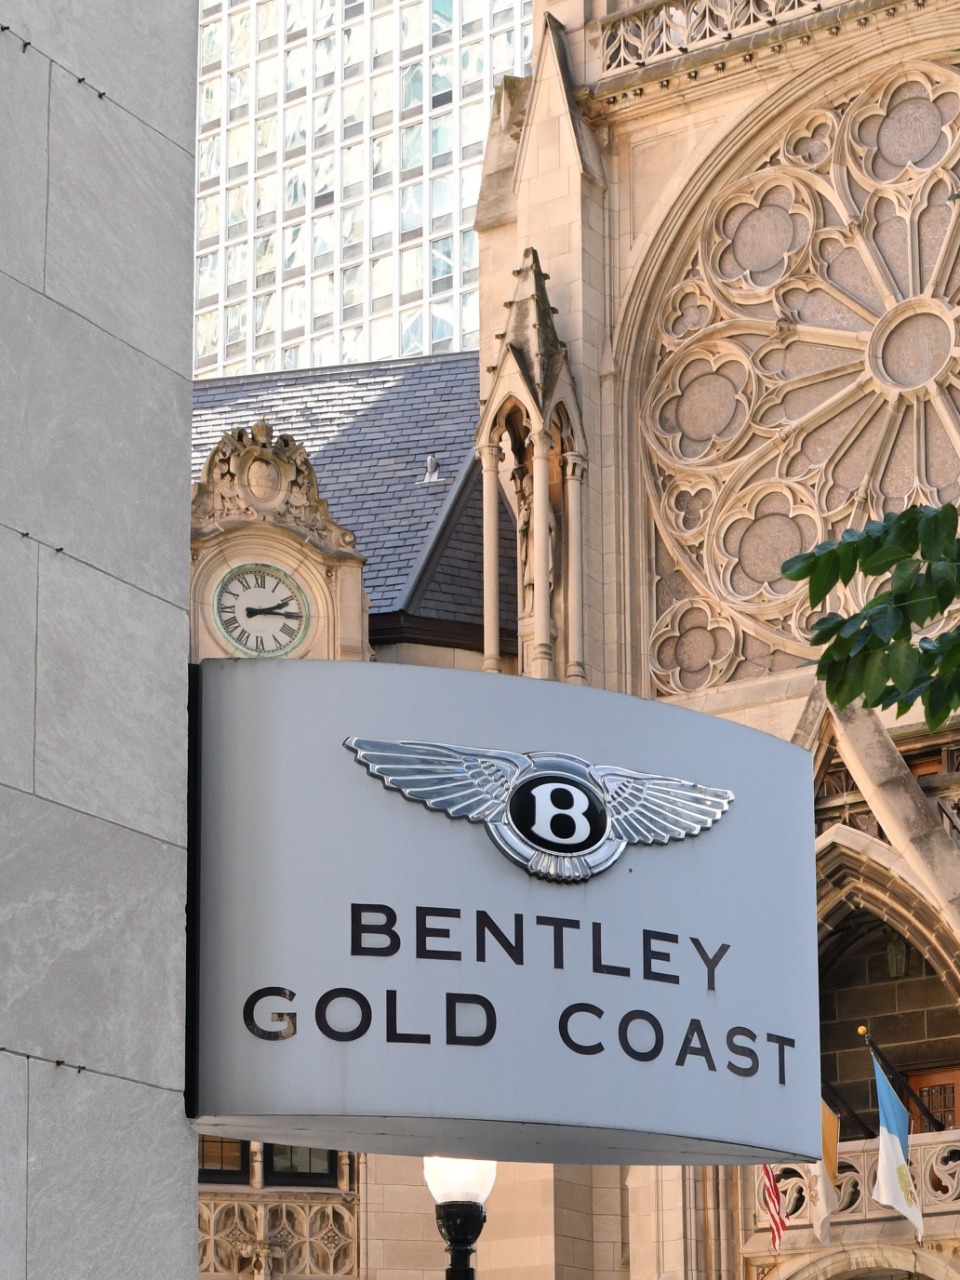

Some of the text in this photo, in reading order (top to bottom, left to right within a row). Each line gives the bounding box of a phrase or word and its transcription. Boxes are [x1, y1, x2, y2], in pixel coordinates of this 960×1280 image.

[530, 783, 592, 844] B
[350, 903, 731, 991] BENTLEY
[242, 986, 796, 1085] GOLD COAST
